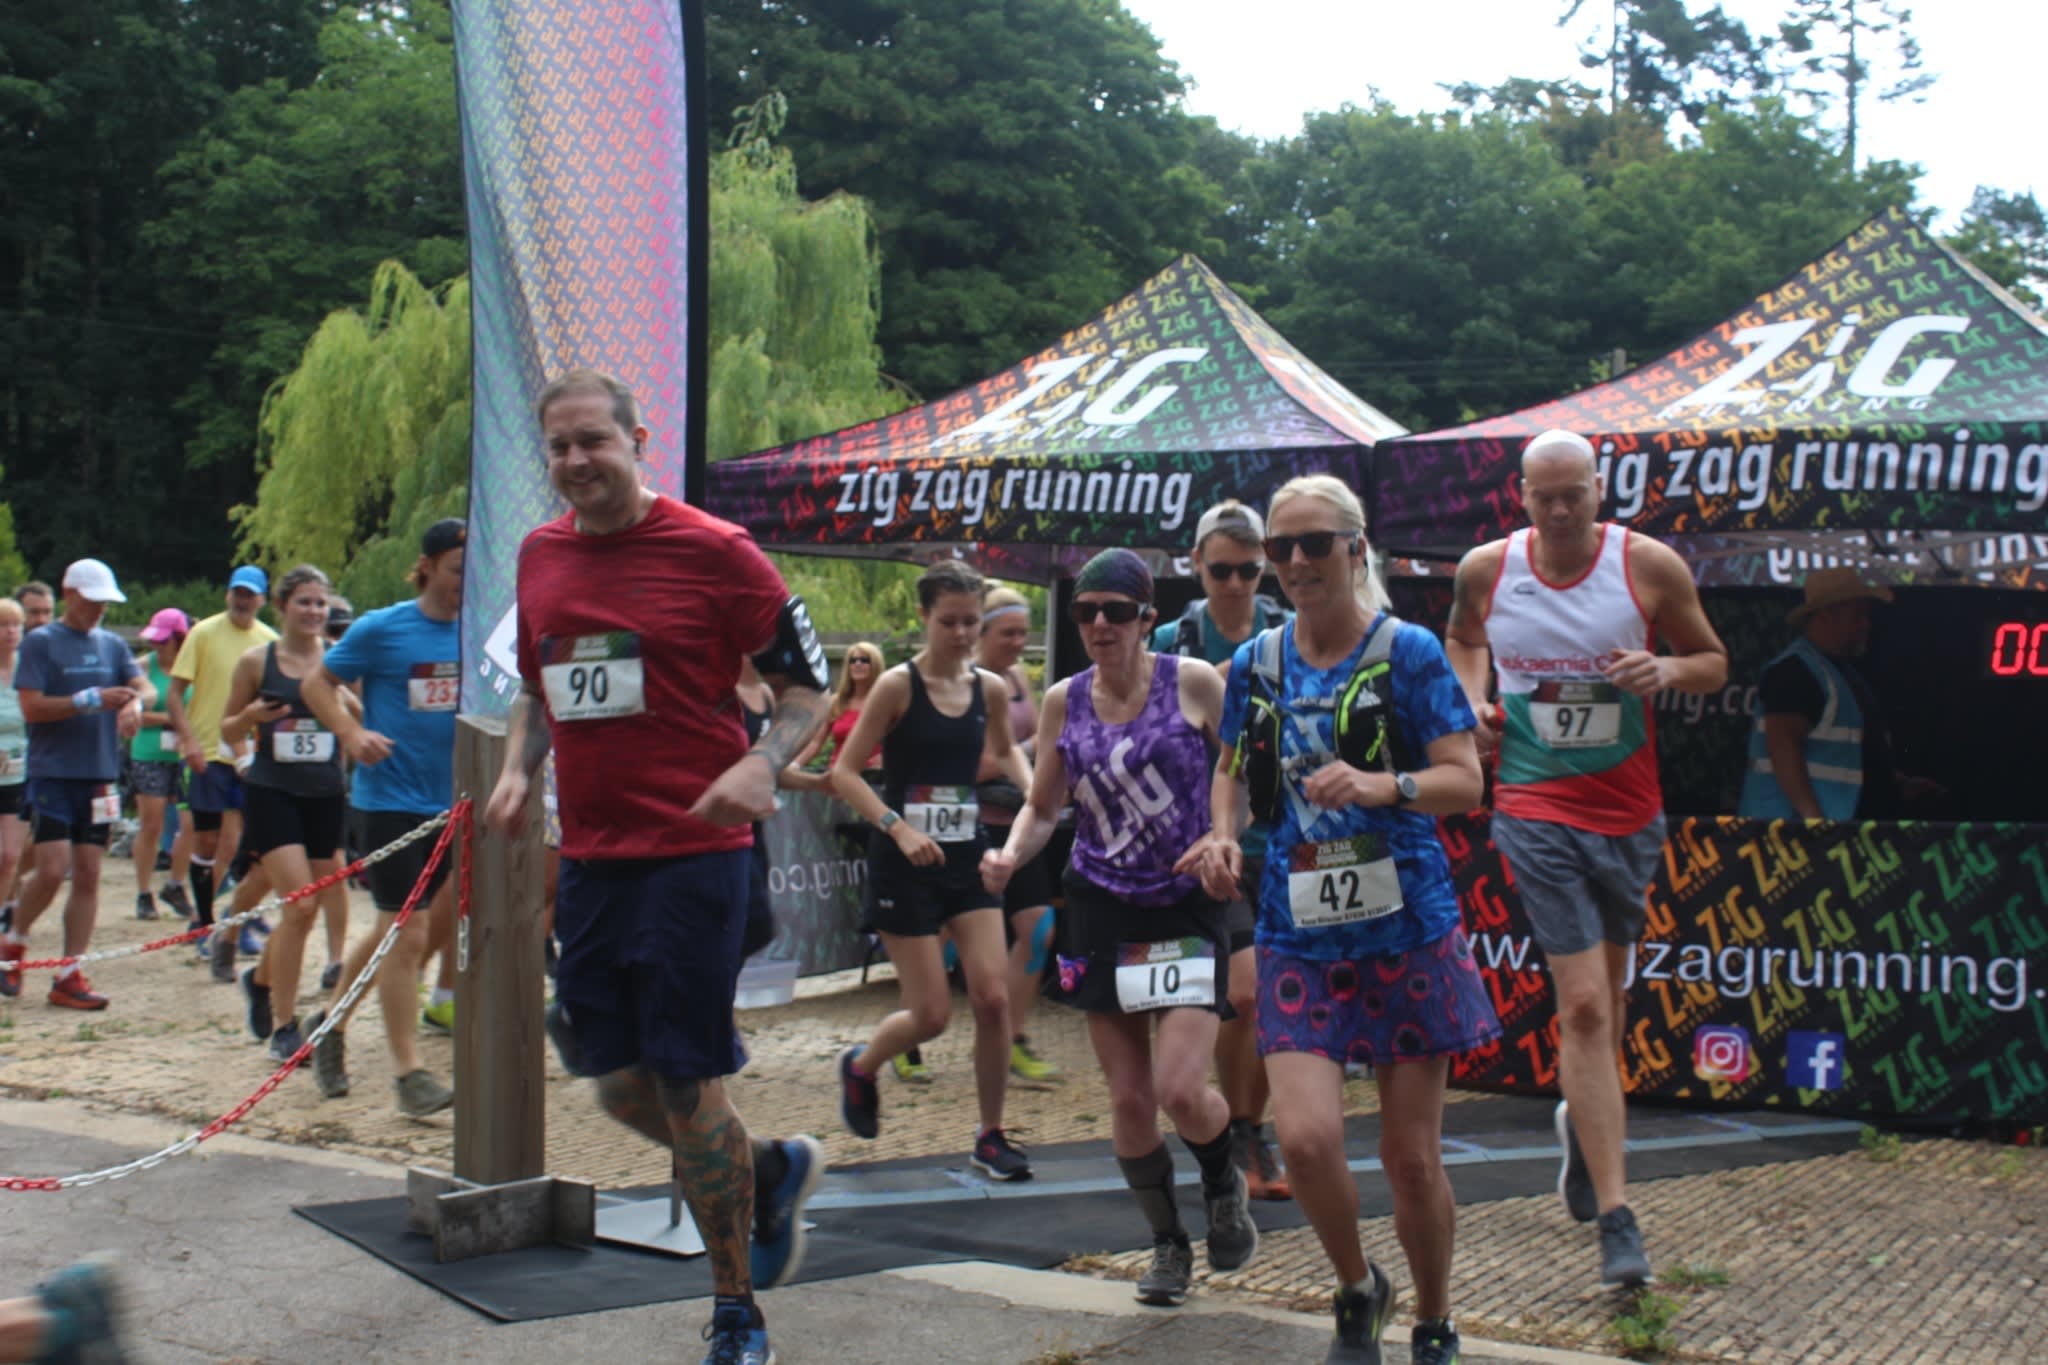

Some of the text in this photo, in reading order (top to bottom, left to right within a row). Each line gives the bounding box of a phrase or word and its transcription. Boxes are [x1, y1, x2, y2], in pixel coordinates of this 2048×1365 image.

[1599, 429, 2048, 519] ig zag running
[834, 459, 1193, 531] zig zag running
[569, 666, 608, 705] 90
[1556, 706, 1592, 737] 97
[293, 734, 317, 755] 85
[925, 807, 963, 833] 104
[1319, 869, 1364, 911] 42
[1149, 964, 1180, 997] 10
